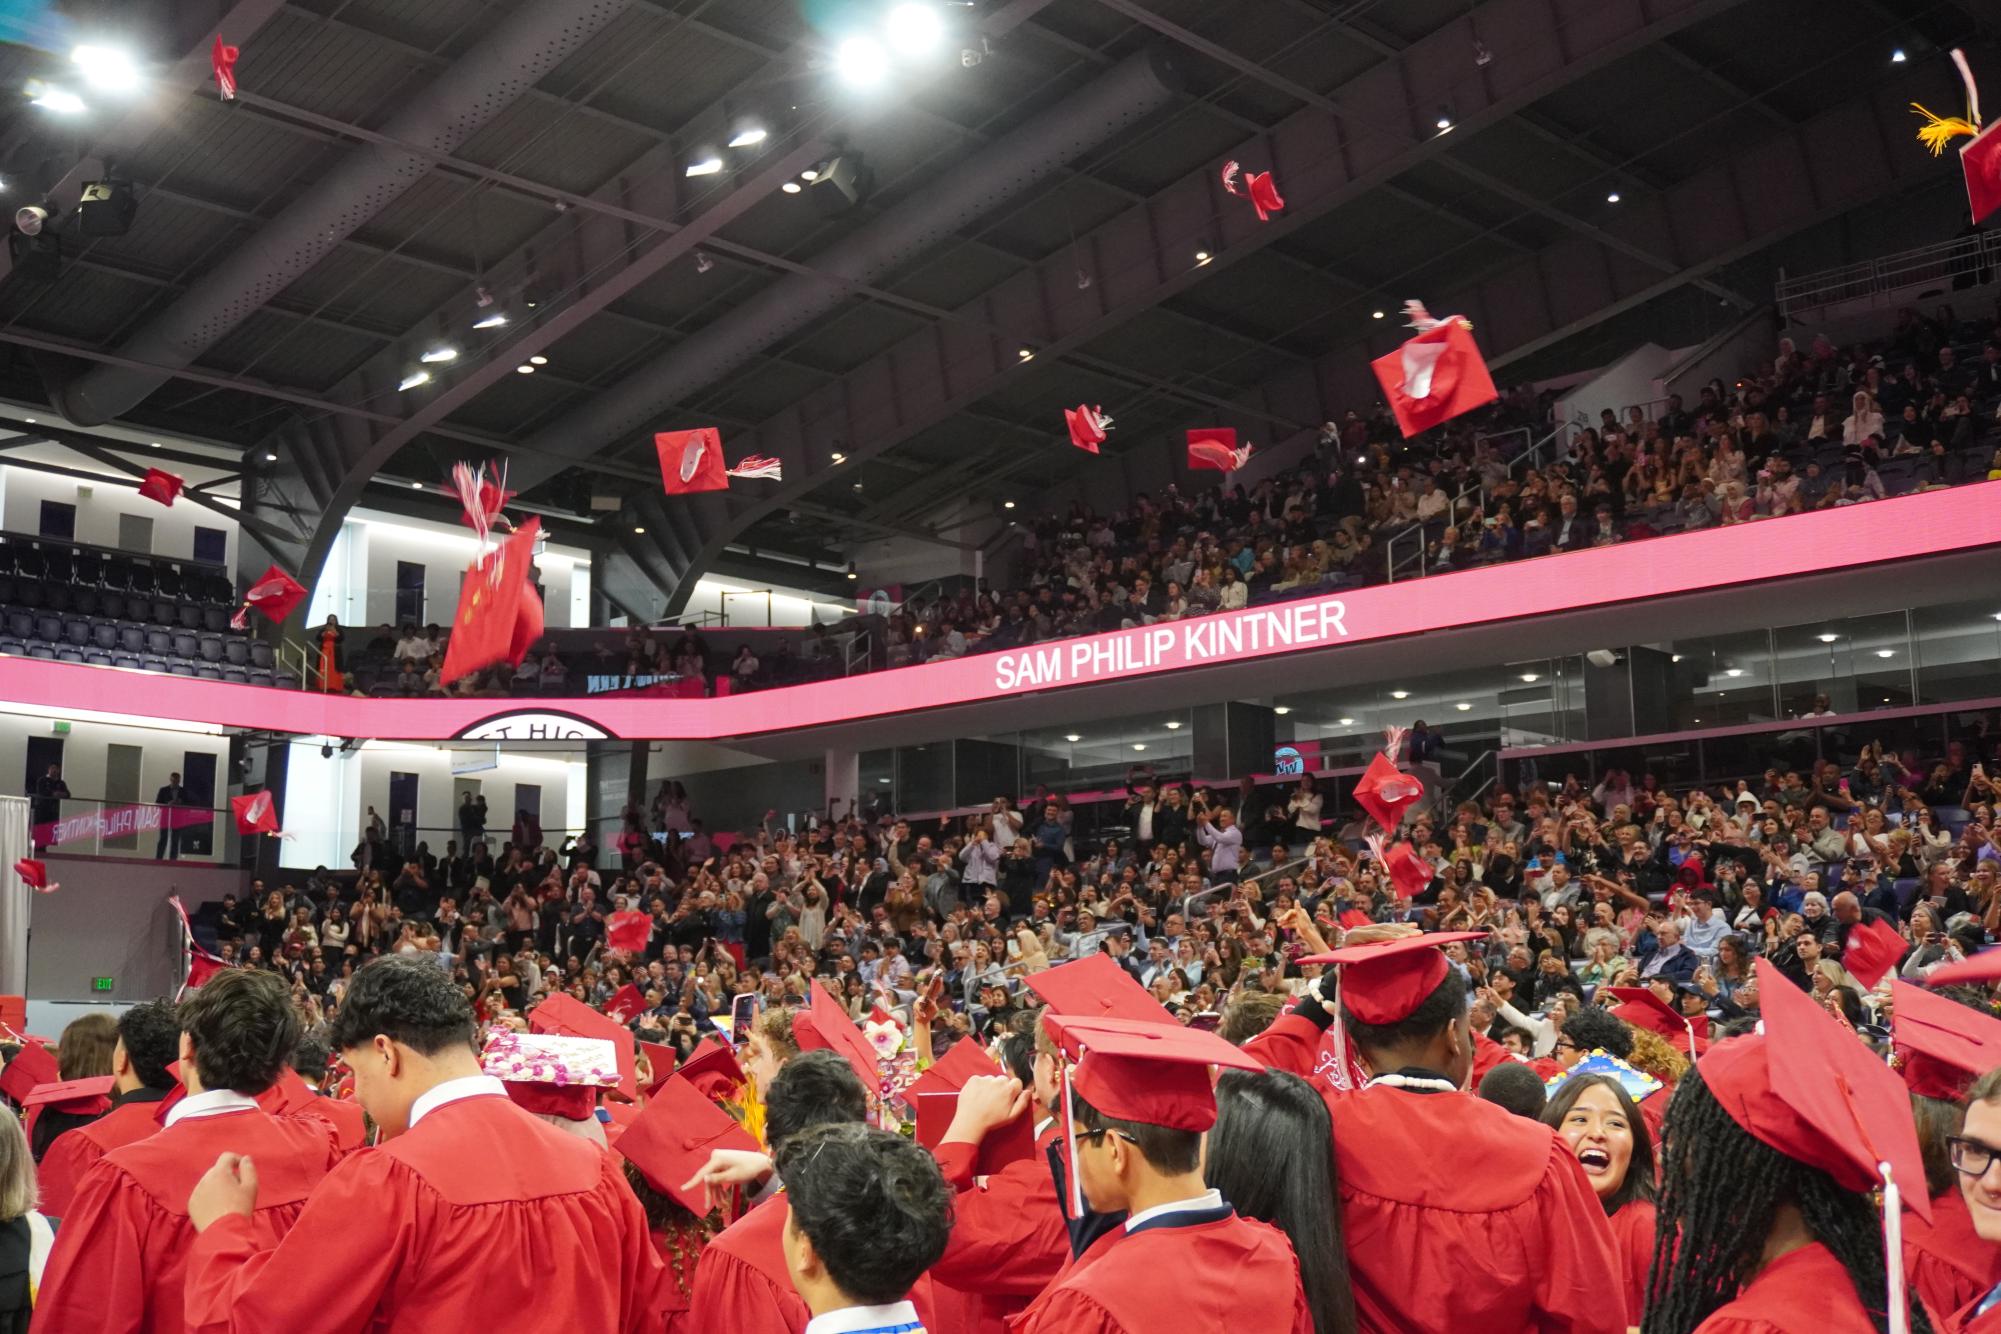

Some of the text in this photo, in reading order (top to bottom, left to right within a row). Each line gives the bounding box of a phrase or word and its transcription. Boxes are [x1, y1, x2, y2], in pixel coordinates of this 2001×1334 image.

[995, 600, 1349, 690] SAM PHILIP KINTNER
[97, 977, 113, 990] EXIT
